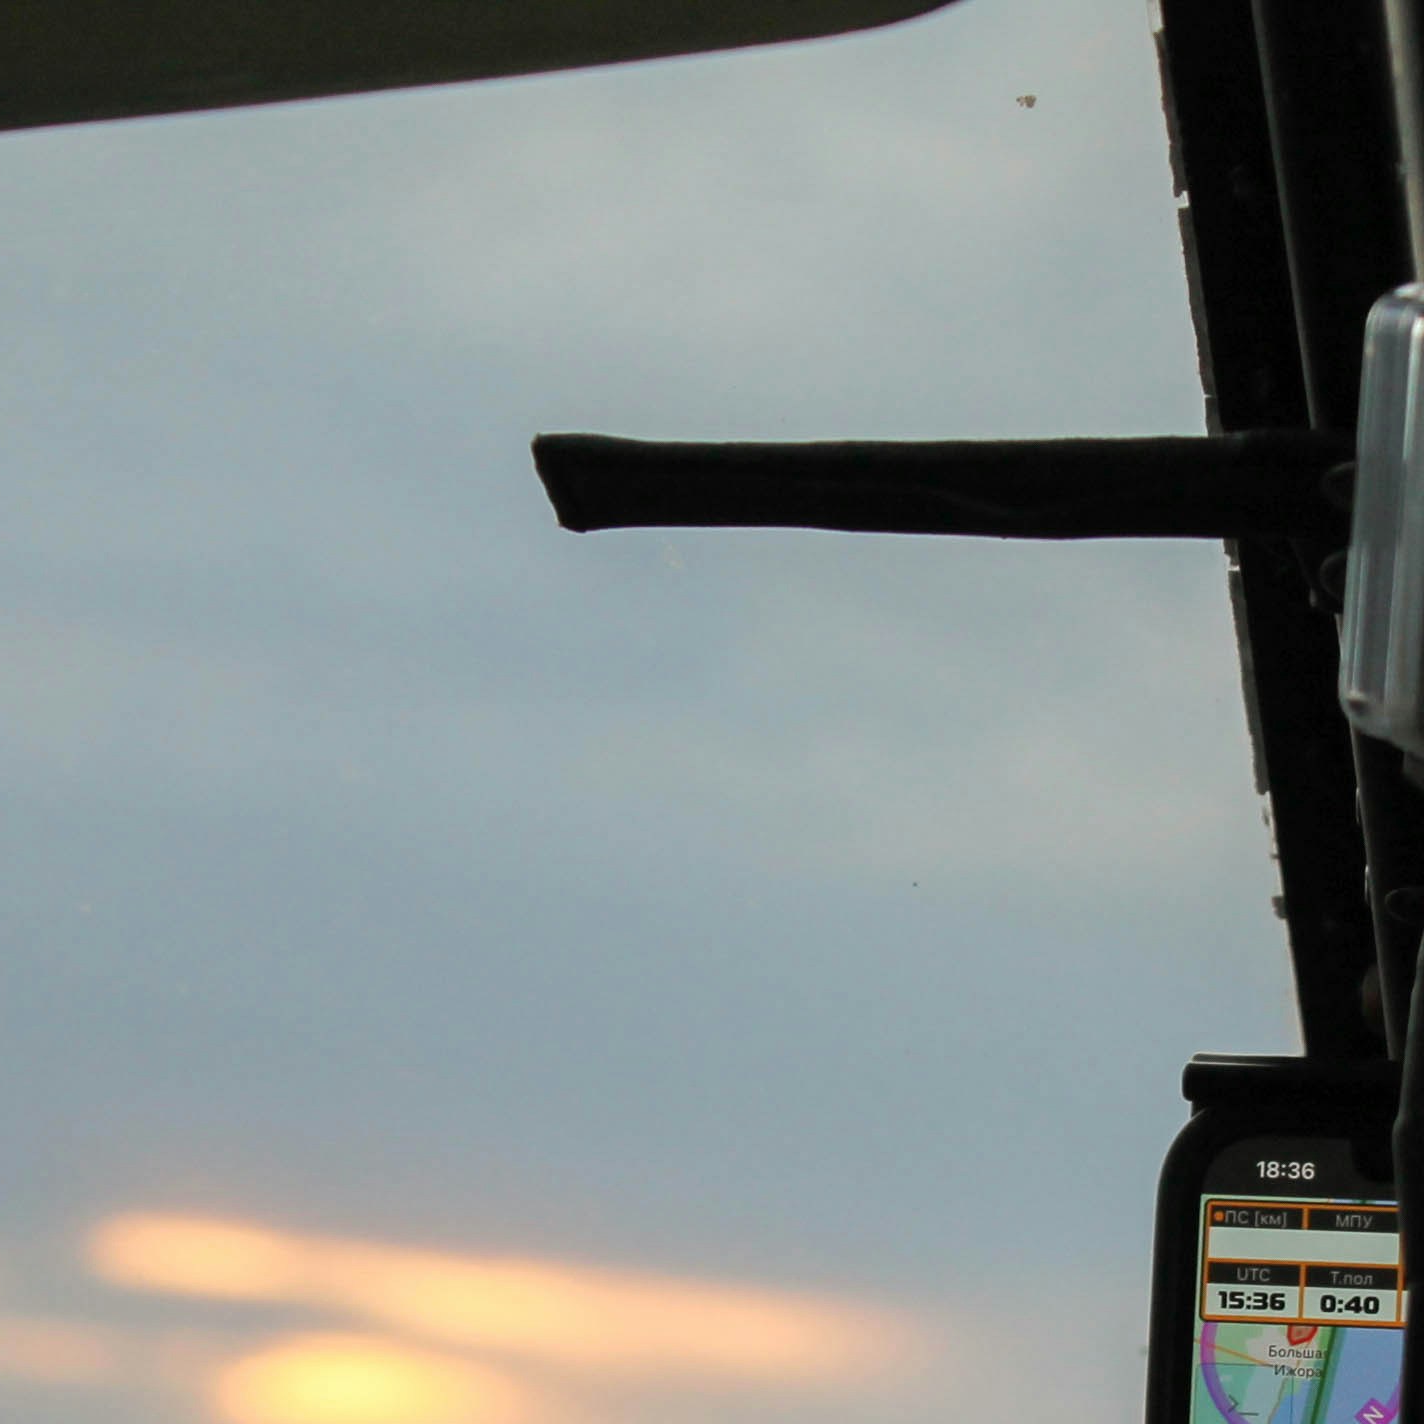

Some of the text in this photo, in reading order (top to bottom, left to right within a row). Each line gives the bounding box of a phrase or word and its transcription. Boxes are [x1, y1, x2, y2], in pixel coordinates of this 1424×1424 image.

[1256, 1160, 1316, 1180] 18:36
[1226, 1211, 1249, 1225] ПС
[1335, 1214, 1373, 1229] МПУ
[1236, 1267, 1271, 1283] UTC
[1331, 1271, 1374, 1286] Т.пол
[1218, 1290, 1286, 1312] 15:36
[1319, 1294, 1380, 1315] 0:40
